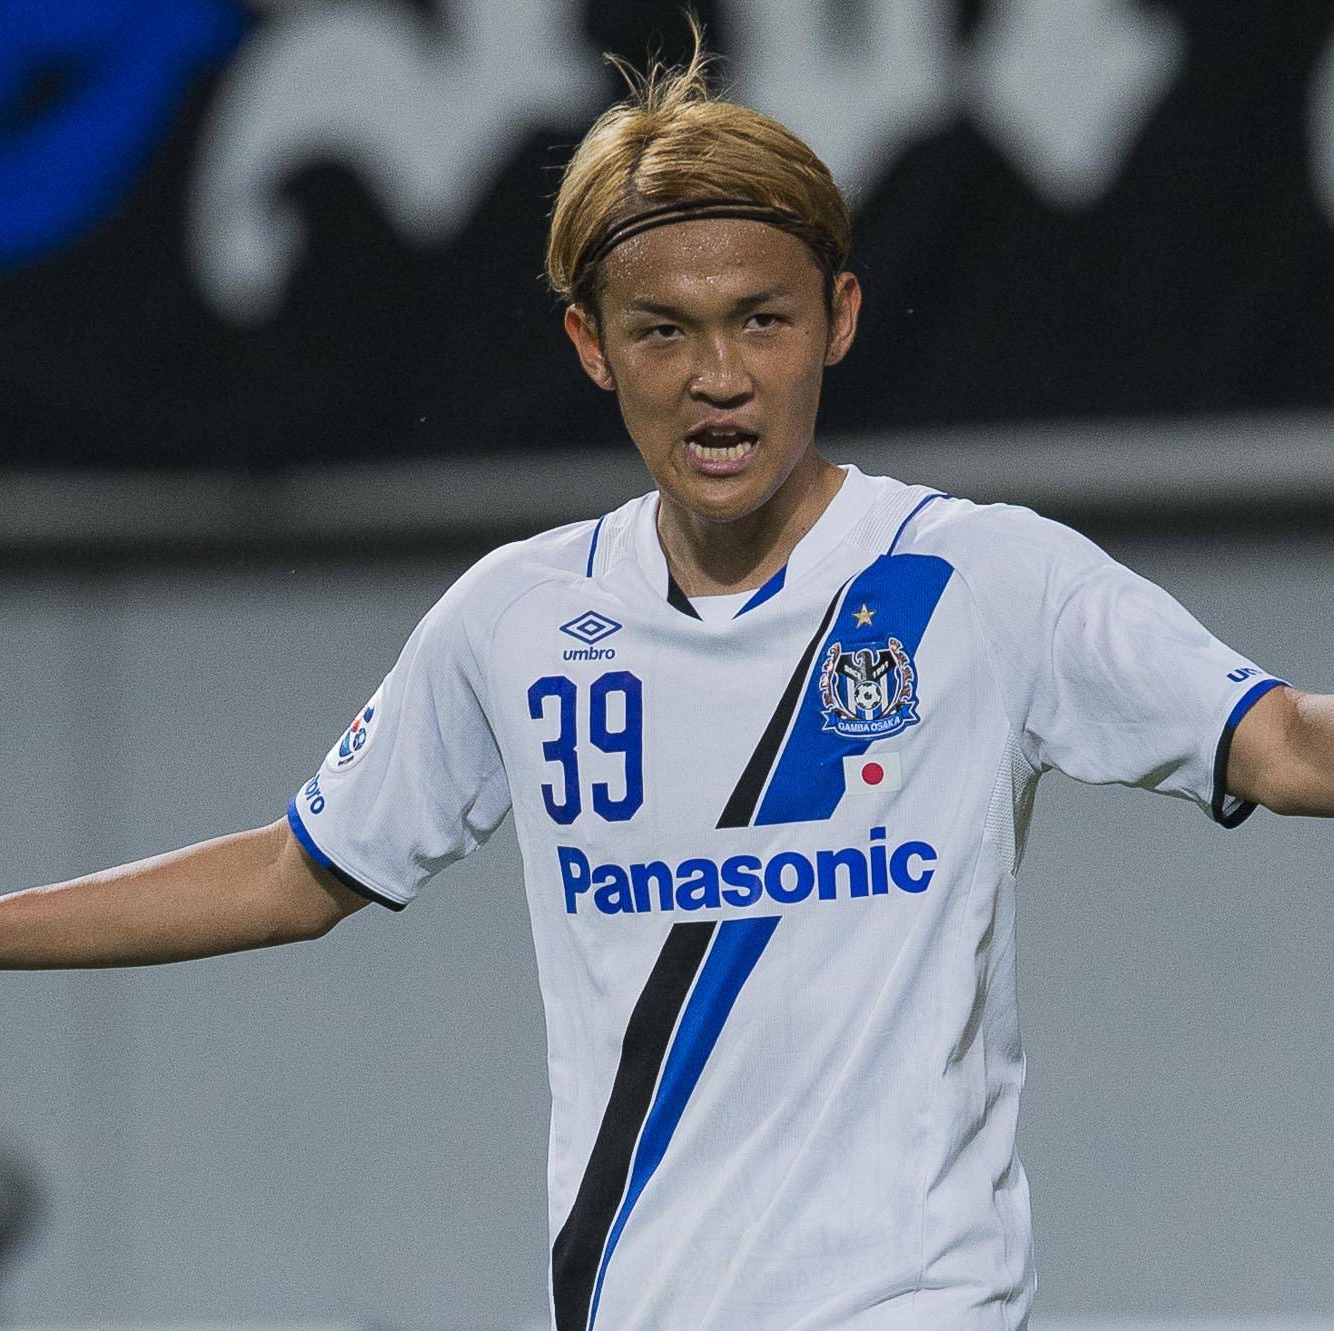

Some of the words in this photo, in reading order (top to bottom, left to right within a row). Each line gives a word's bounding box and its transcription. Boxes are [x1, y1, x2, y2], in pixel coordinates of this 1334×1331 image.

[563, 646, 615, 661] umbro
[527, 671, 644, 825] 39
[838, 720, 870, 733] GAMBA
[870, 716, 901, 732] OSAKA
[557, 826, 938, 914] Panasonic
